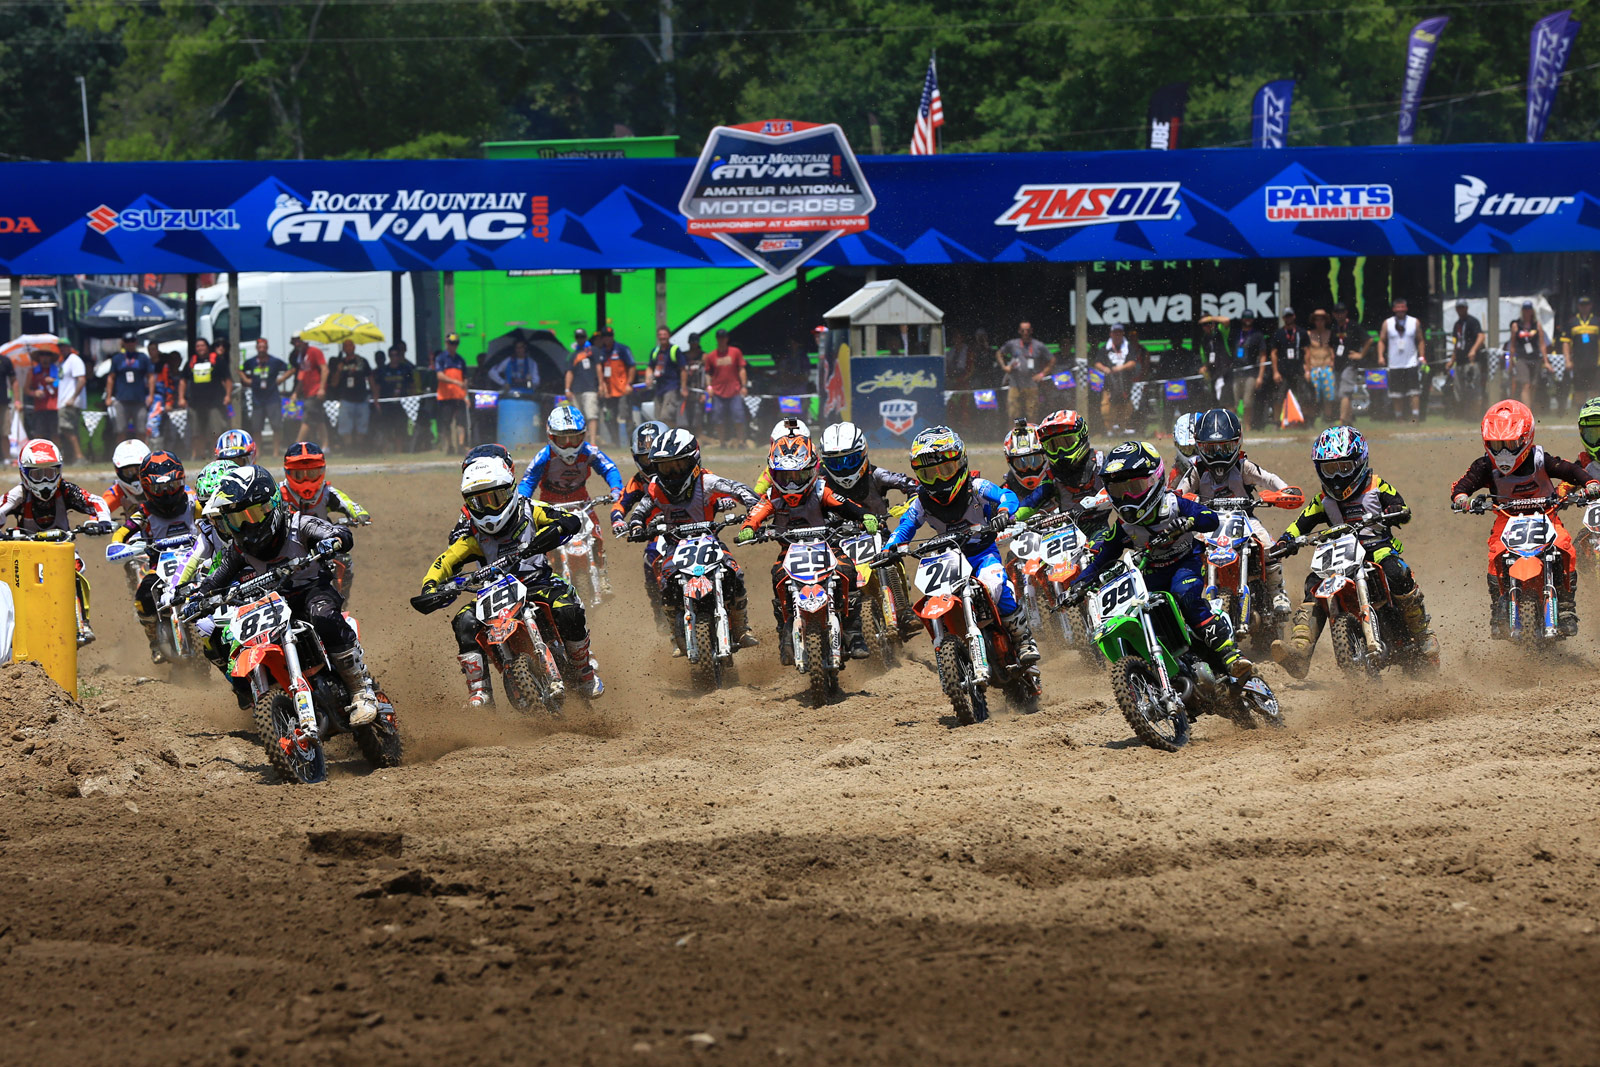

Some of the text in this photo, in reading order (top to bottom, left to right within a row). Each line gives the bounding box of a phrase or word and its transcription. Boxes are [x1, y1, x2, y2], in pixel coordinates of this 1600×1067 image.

[728, 153, 830, 164] ROCKY MOUNTAIN
[307, 190, 527, 211] ROCKY MOUNTAIN
[703, 184, 854, 197] AMATEUR NATIONAL
[1266, 185, 1393, 206] PARTS
[700, 198, 855, 214] MOTOCROSS
[1000, 185, 1178, 229] AMSOIL
[1267, 206, 1392, 220] UNLIMITED
[1480, 193, 1575, 215] thor
[0, 217, 41, 233] DA
[119, 209, 236, 230] SUZUKI
[531, 196, 549, 243] .com
[690, 221, 766, 229] CHAMPIONSHIP
[768, 220, 782, 228] AT
[784, 219, 828, 227] LORETTA
[1070, 283, 1279, 326] Kawasaki
[1508, 522, 1549, 545] 32
[675, 543, 720, 569] 36
[846, 537, 876, 561] 12
[1047, 534, 1078, 559] 22
[1315, 542, 1356, 572] 13
[790, 551, 830, 573] 29
[925, 560, 960, 594] 24
[480, 583, 519, 619] 19
[1102, 578, 1137, 615] 99
[240, 604, 285, 641] 83
